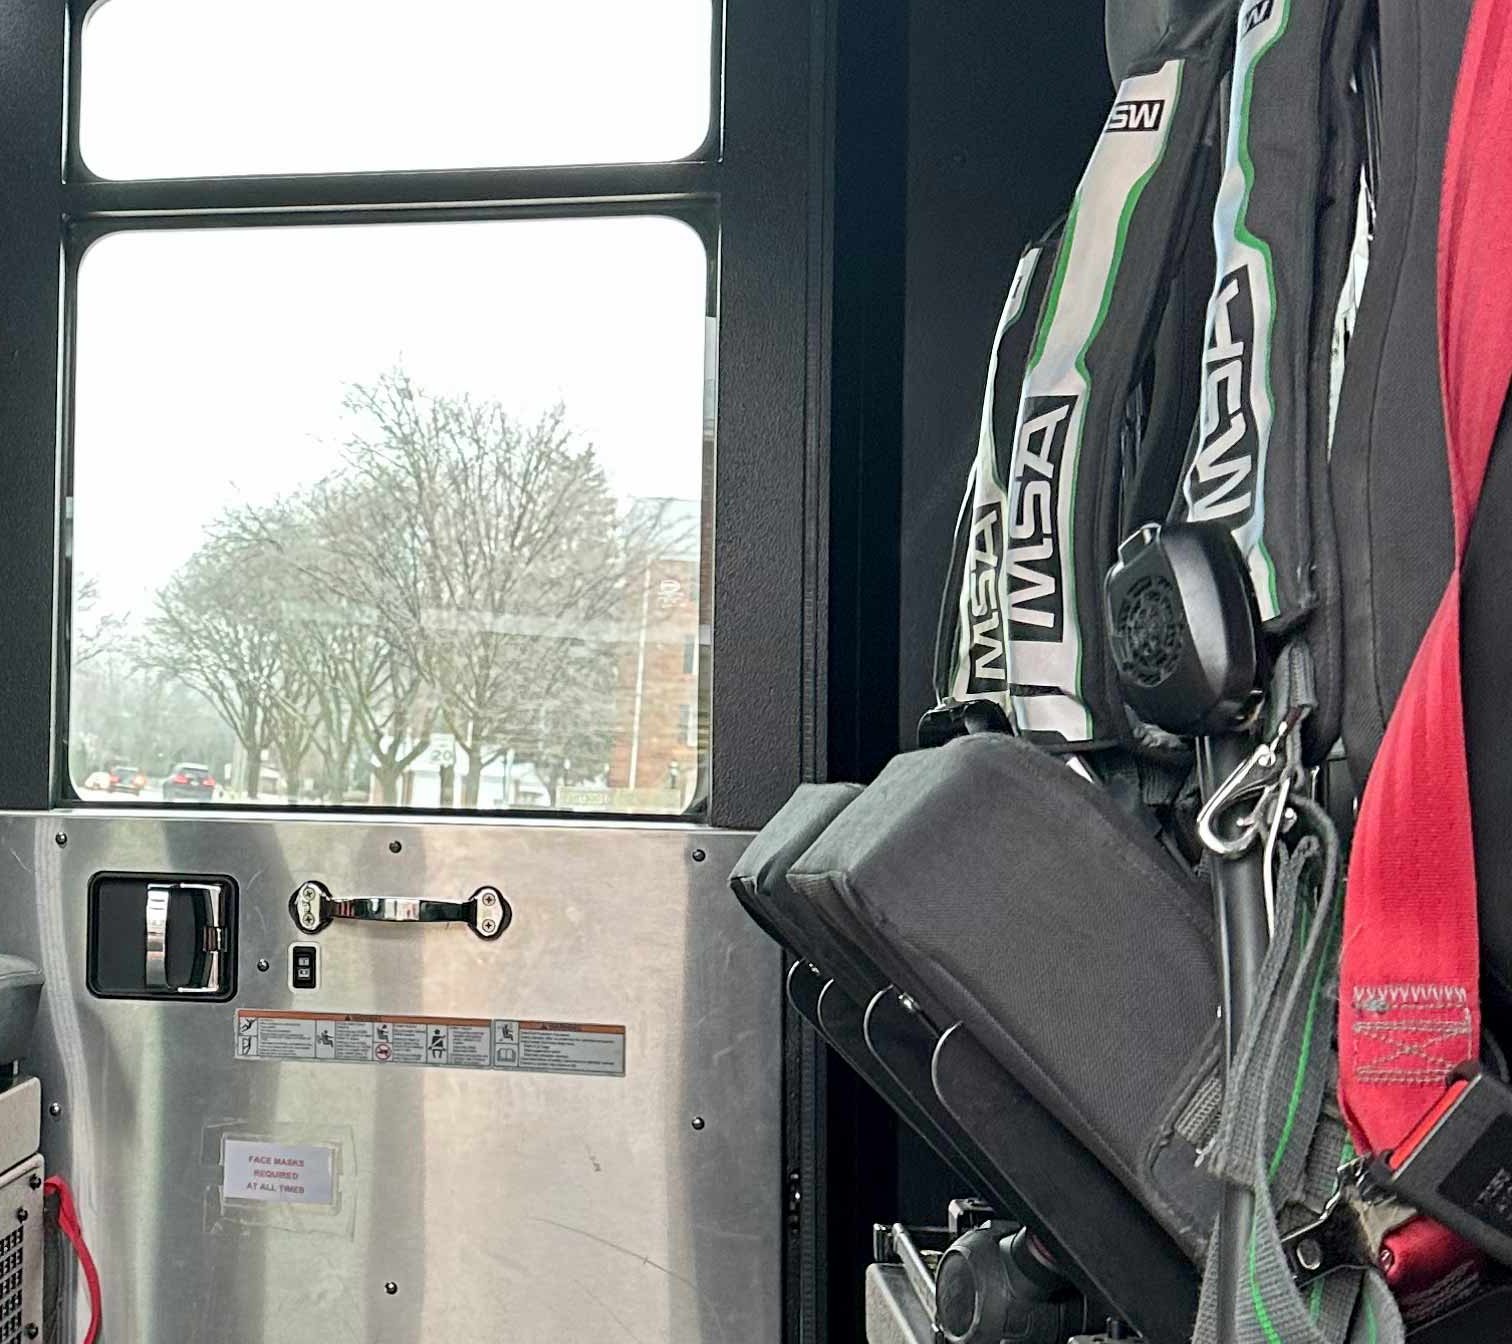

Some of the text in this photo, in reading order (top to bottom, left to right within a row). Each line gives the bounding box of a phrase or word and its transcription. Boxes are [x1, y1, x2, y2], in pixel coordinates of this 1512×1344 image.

[1007, 404, 1070, 629] MSA
[969, 509, 1006, 680] MSA
[248, 1155, 305, 1167] FACE MASKS
[254, 1169, 298, 1180] REQUIRED
[247, 1182, 305, 1194] AT ALL TIMES
